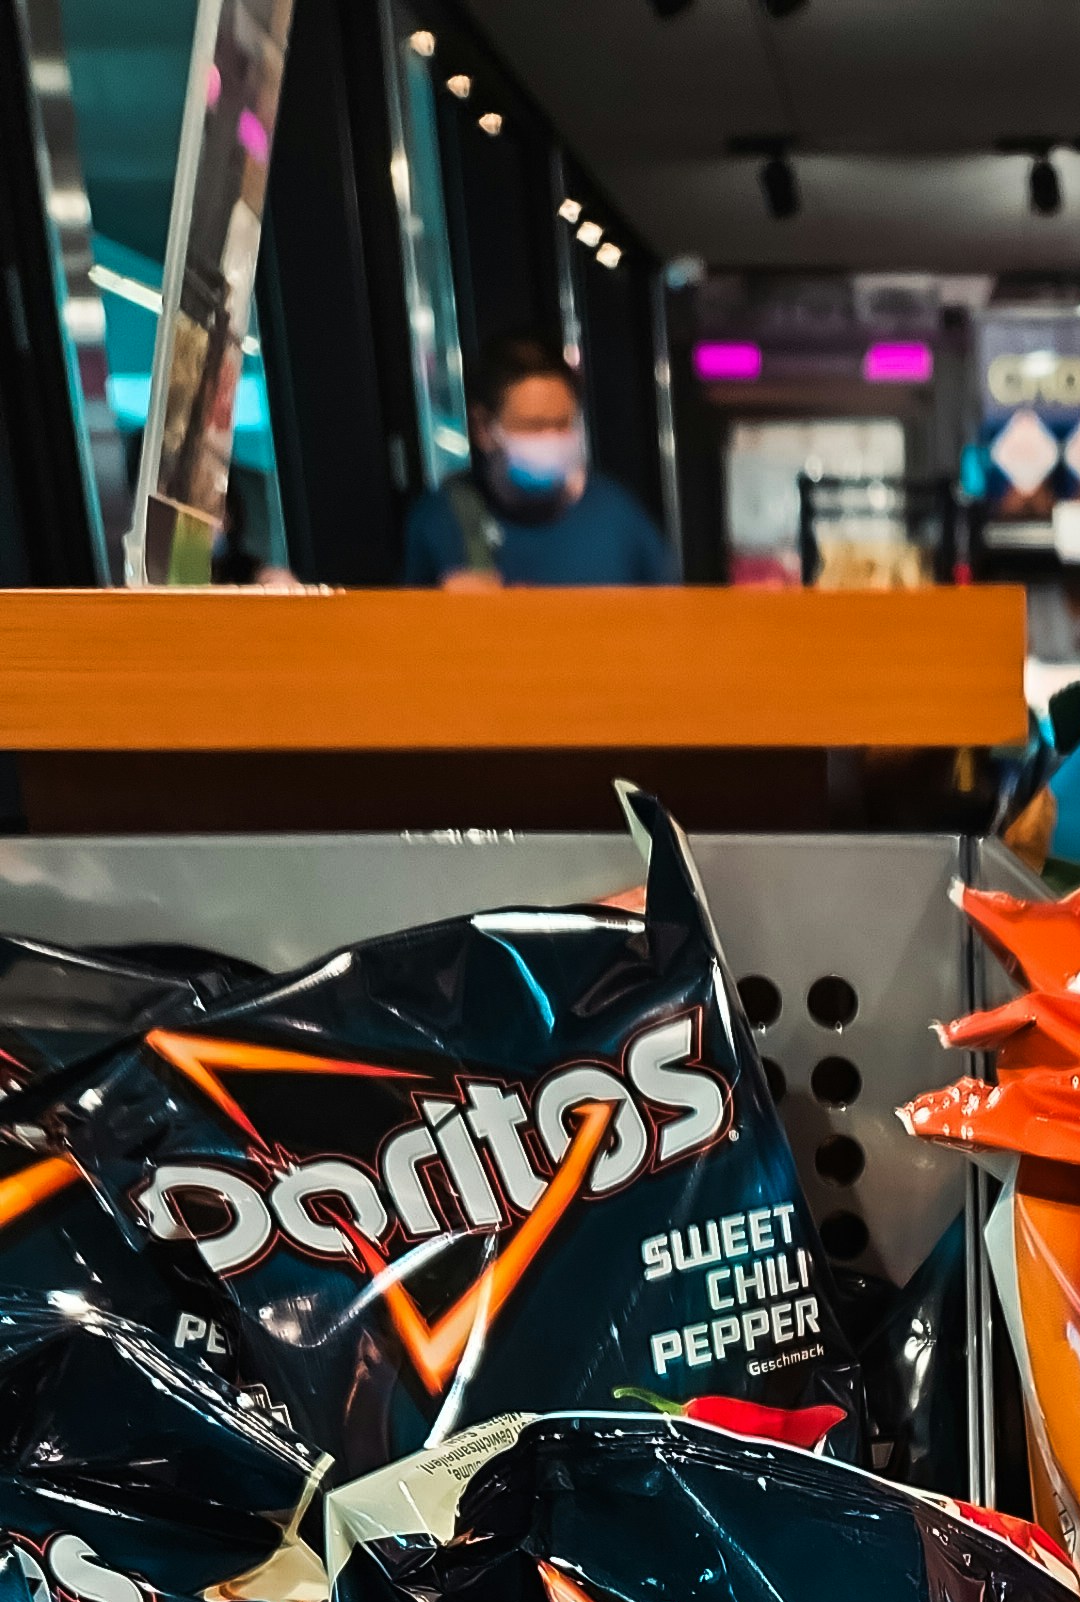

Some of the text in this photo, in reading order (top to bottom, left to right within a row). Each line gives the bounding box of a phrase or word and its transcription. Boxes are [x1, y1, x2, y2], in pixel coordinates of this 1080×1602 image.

[144, 1018, 725, 1272] Doritos
[642, 1202, 795, 1281] SWEET
[706, 1247, 810, 1310] CHILI
[651, 1296, 821, 1375] PEPPER
[748, 1344, 825, 1376] Geschmack
